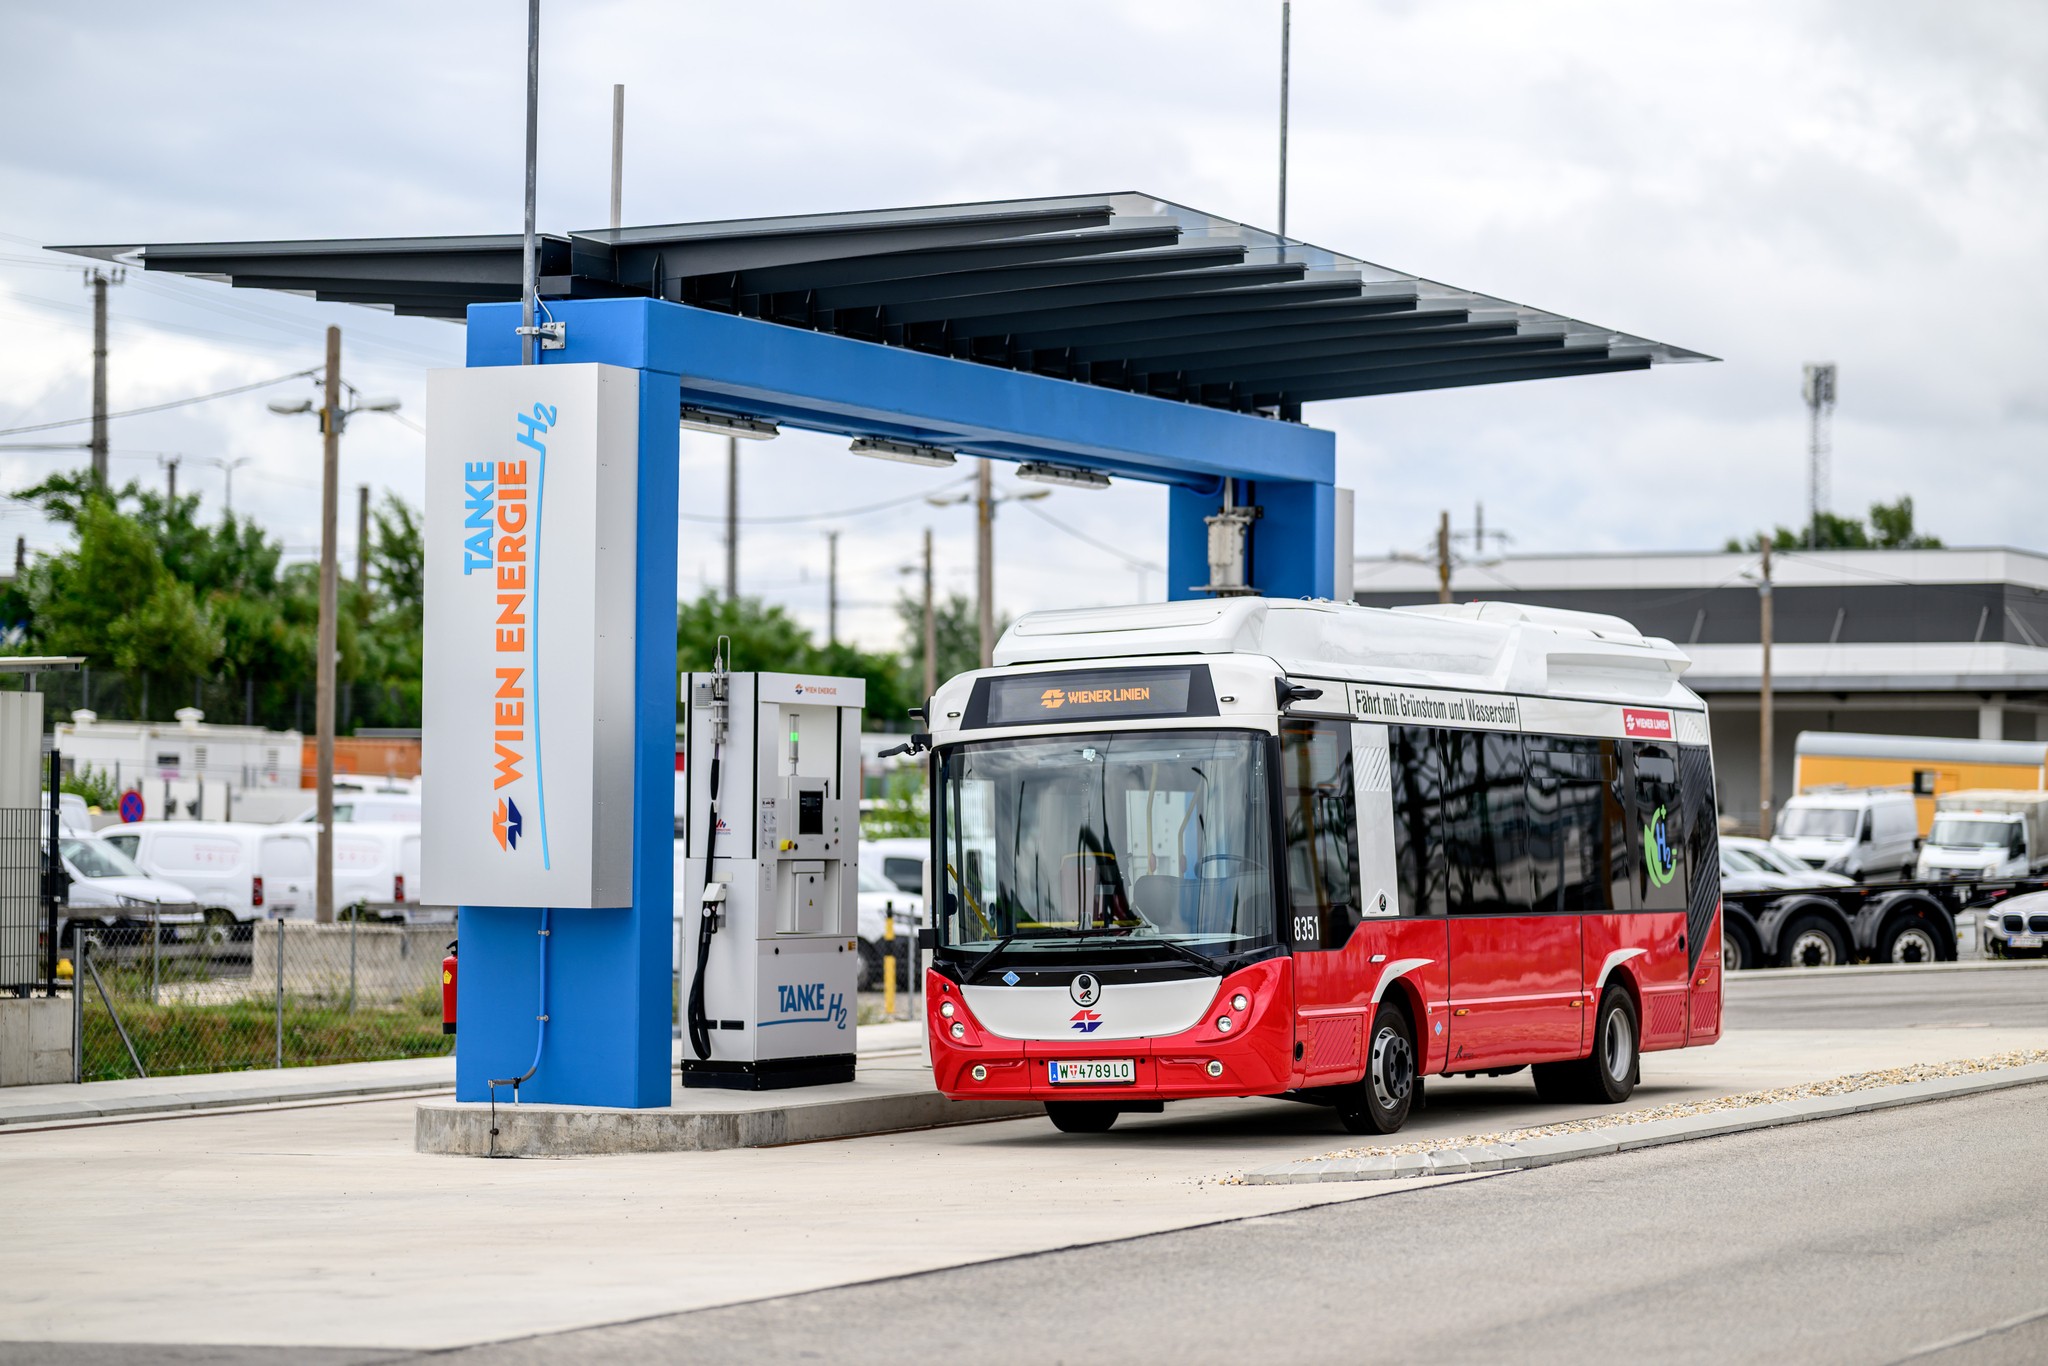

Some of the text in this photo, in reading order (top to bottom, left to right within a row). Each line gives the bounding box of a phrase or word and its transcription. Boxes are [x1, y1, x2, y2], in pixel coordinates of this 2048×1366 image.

[464, 461, 495, 576] TANKE
[493, 459, 528, 791] WIEN ENERGIE
[1067, 687, 1150, 704] WIENER LINIEN
[1354, 689, 1518, 724] Fährt mit Grünstrom und Wasserstoff
[1293, 915, 1320, 941] 8351
[778, 983, 825, 1013] TANKE
